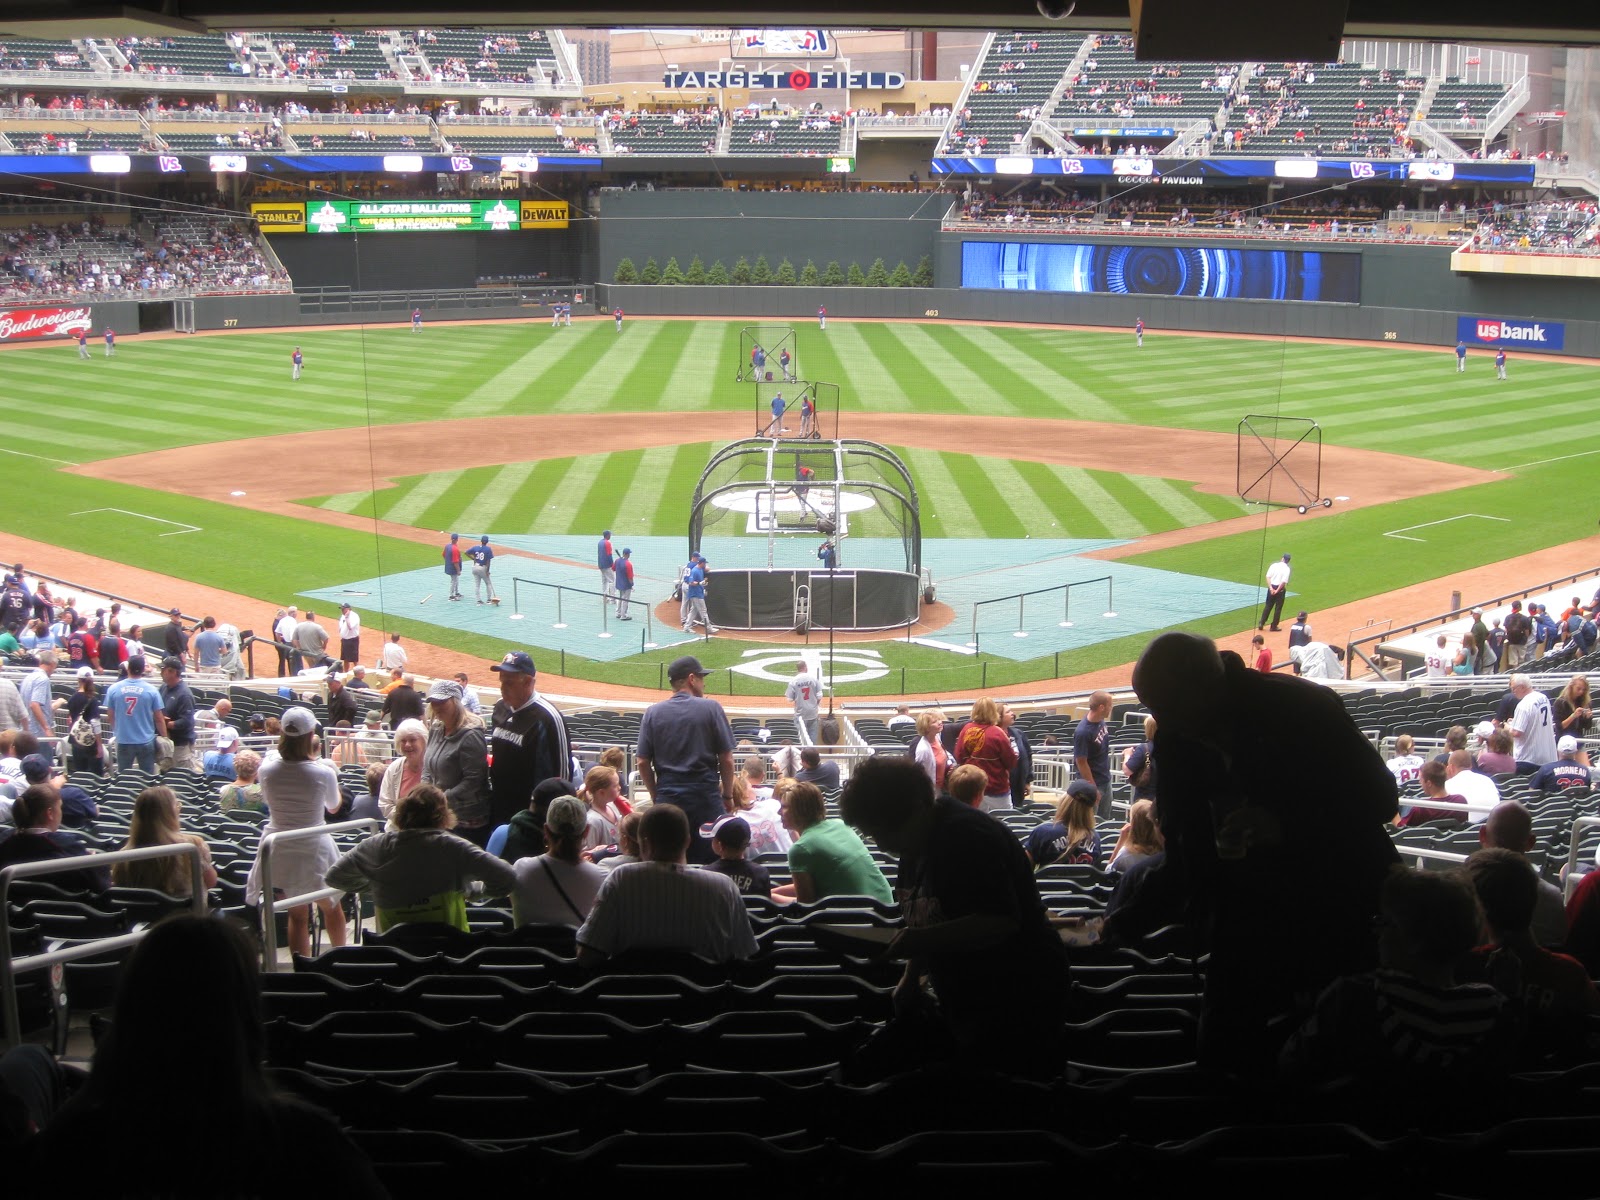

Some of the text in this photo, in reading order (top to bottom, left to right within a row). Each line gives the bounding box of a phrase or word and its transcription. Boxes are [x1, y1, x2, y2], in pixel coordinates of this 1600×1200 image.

[665, 72, 905, 89] TARGET FIELD
[1162, 176, 1203, 185] PAVILION
[411, 203, 471, 213] BALLOTING
[257, 213, 300, 223] STANLEY
[924, 309, 939, 317] 403
[0, 308, 84, 338] Budweiser
[223, 318, 238, 327] 377
[1384, 331, 1397, 340] 365
[1427, 656, 1441, 669] 33
[801, 687, 810, 700] 7
[124, 696, 138, 716] 7
[1540, 706, 1548, 727] 7
[1553, 766, 1588, 777] MORNEAU
